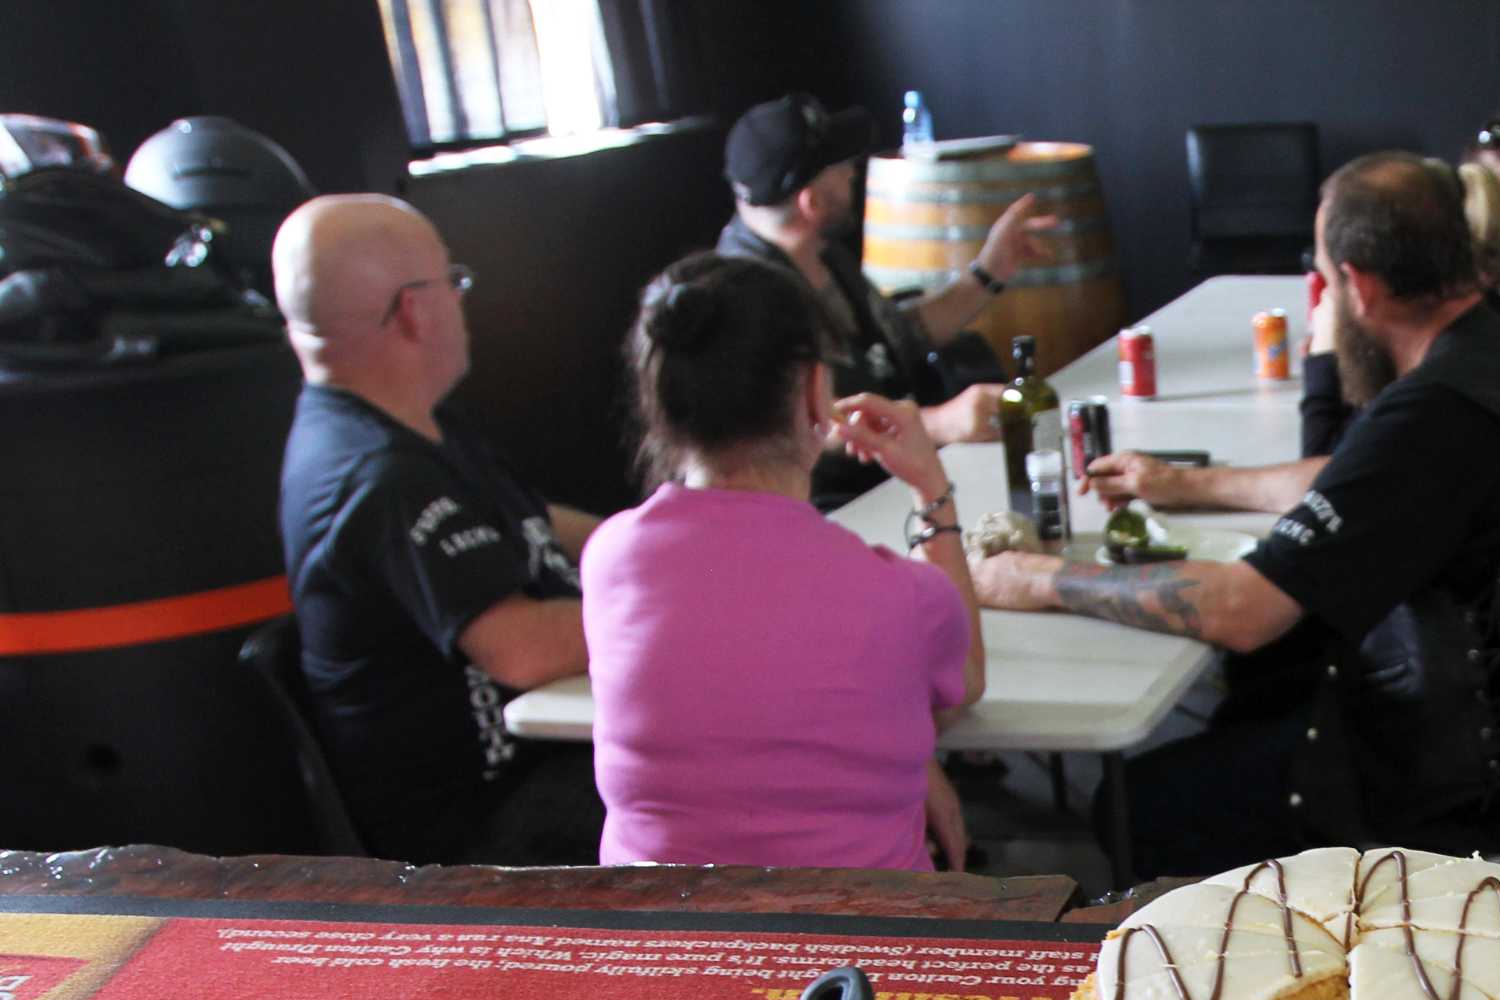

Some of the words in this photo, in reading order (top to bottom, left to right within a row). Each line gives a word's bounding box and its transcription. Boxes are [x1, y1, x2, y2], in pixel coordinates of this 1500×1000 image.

[314, 932, 376, 942] close
[378, 930, 432, 941] very
[437, 933, 454, 942] a
[218, 940, 322, 954] Draught
[554, 936, 640, 948] named
[644, 939, 800, 952] backpackers
[324, 944, 412, 955] Carlton
[414, 944, 464, 956] why
[470, 946, 493, 957] is
[496, 947, 572, 961] Which
[805, 944, 912, 955] (Swedish
[916, 947, 1025, 958] member
[1026, 950, 1084, 960] staff
[271, 956, 328, 966] beer
[578, 950, 662, 962] magic.
[665, 952, 724, 963] pure
[328, 957, 384, 967] cold
[388, 958, 450, 968] fresh
[454, 959, 493, 970] the
[772, 956, 850, 968] forms.
[856, 958, 917, 970] head
[922, 960, 1012, 972] perfect
[594, 963, 698, 976] skilfully
[703, 966, 774, 978] being
[1016, 962, 1056, 974] the
[1062, 965, 1090, 974] as
[888, 973, 982, 986] Carlton
[986, 976, 1048, 986] your
